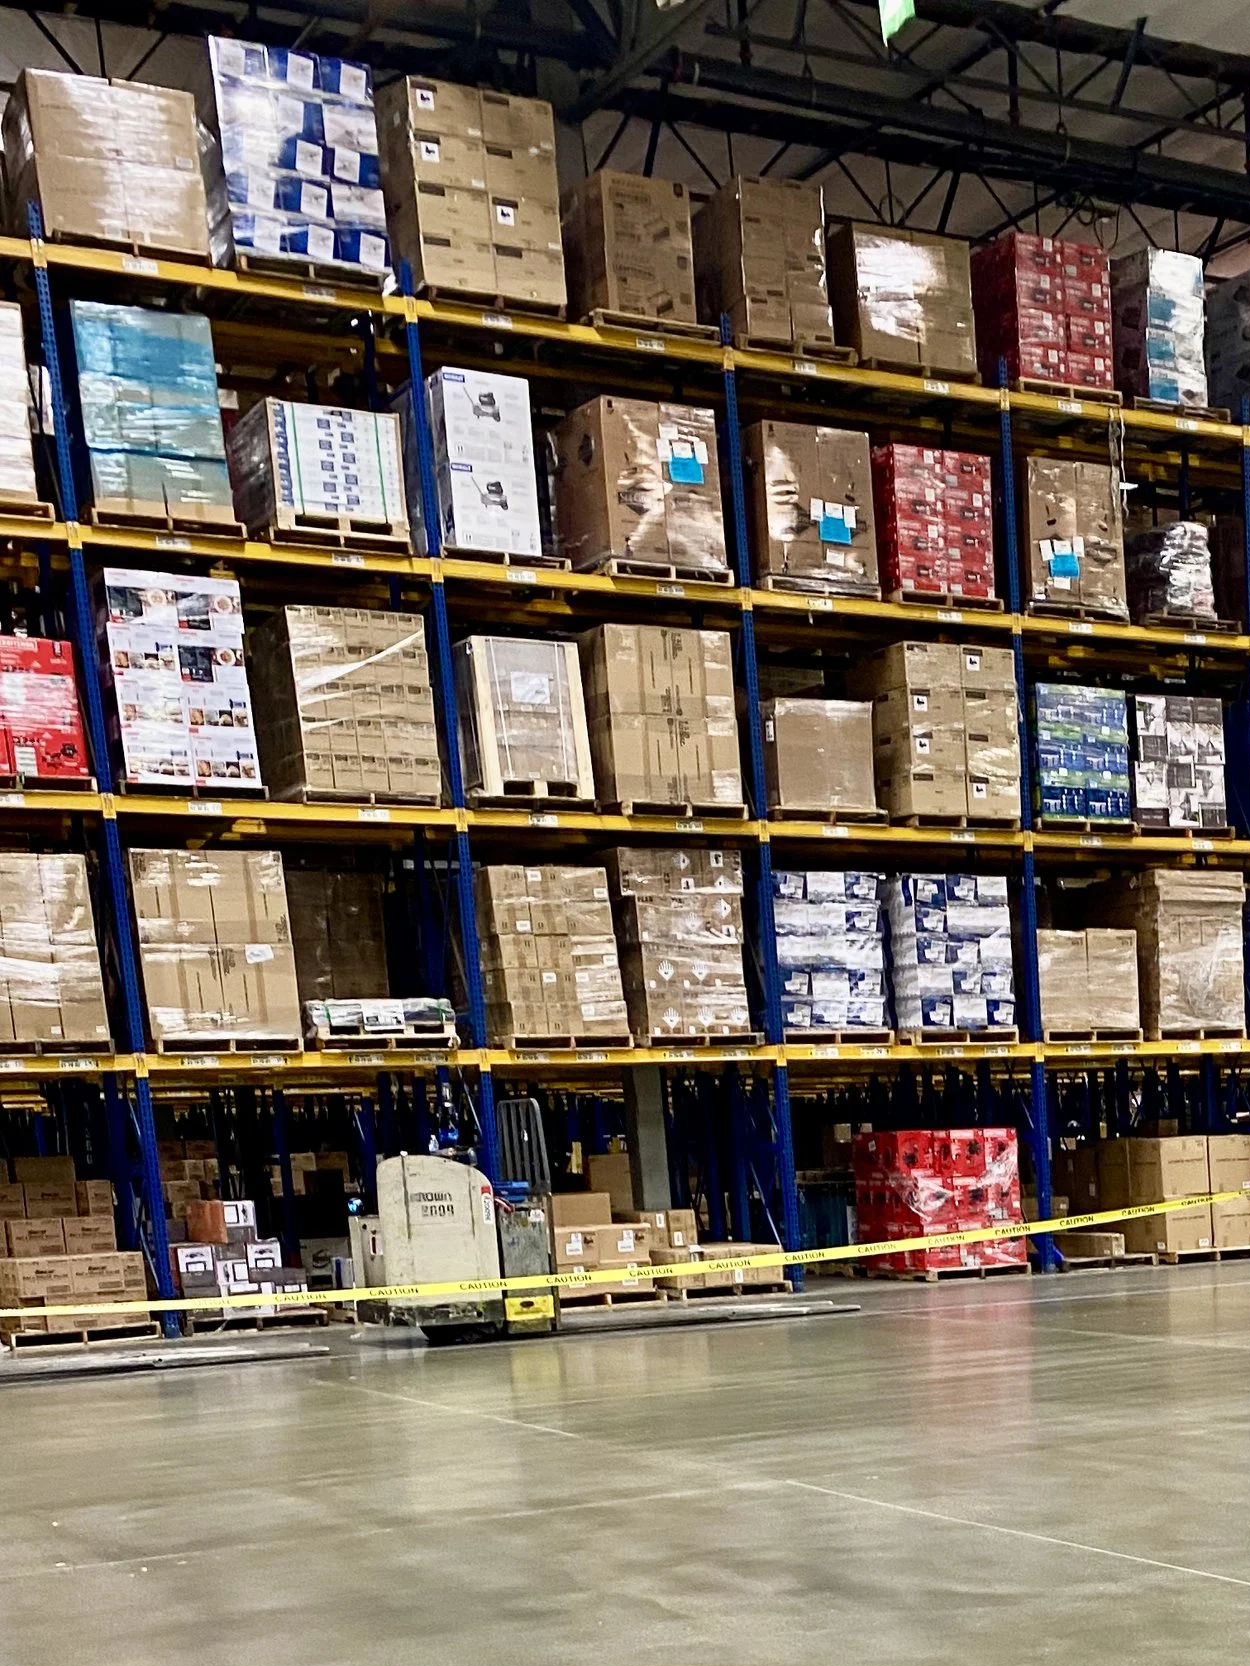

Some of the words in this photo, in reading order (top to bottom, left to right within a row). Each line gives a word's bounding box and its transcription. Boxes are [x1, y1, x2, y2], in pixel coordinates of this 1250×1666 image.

[1121, 1206, 1155, 1217] CAUTION
[1060, 1216, 1094, 1227] CAUTION
[994, 1225, 1031, 1237] CAUTION
[928, 1232, 965, 1245] CAUTION
[858, 1243, 896, 1254] CAUTION
[784, 1252, 825, 1262] CAUTION
[708, 1259, 751, 1270] CAUTION
[629, 1268, 673, 1278] CAUTION
[546, 1274, 592, 1284] CAUTION
[459, 1281, 508, 1291] CAUTION
[369, 1287, 419, 1297] CAUTION
